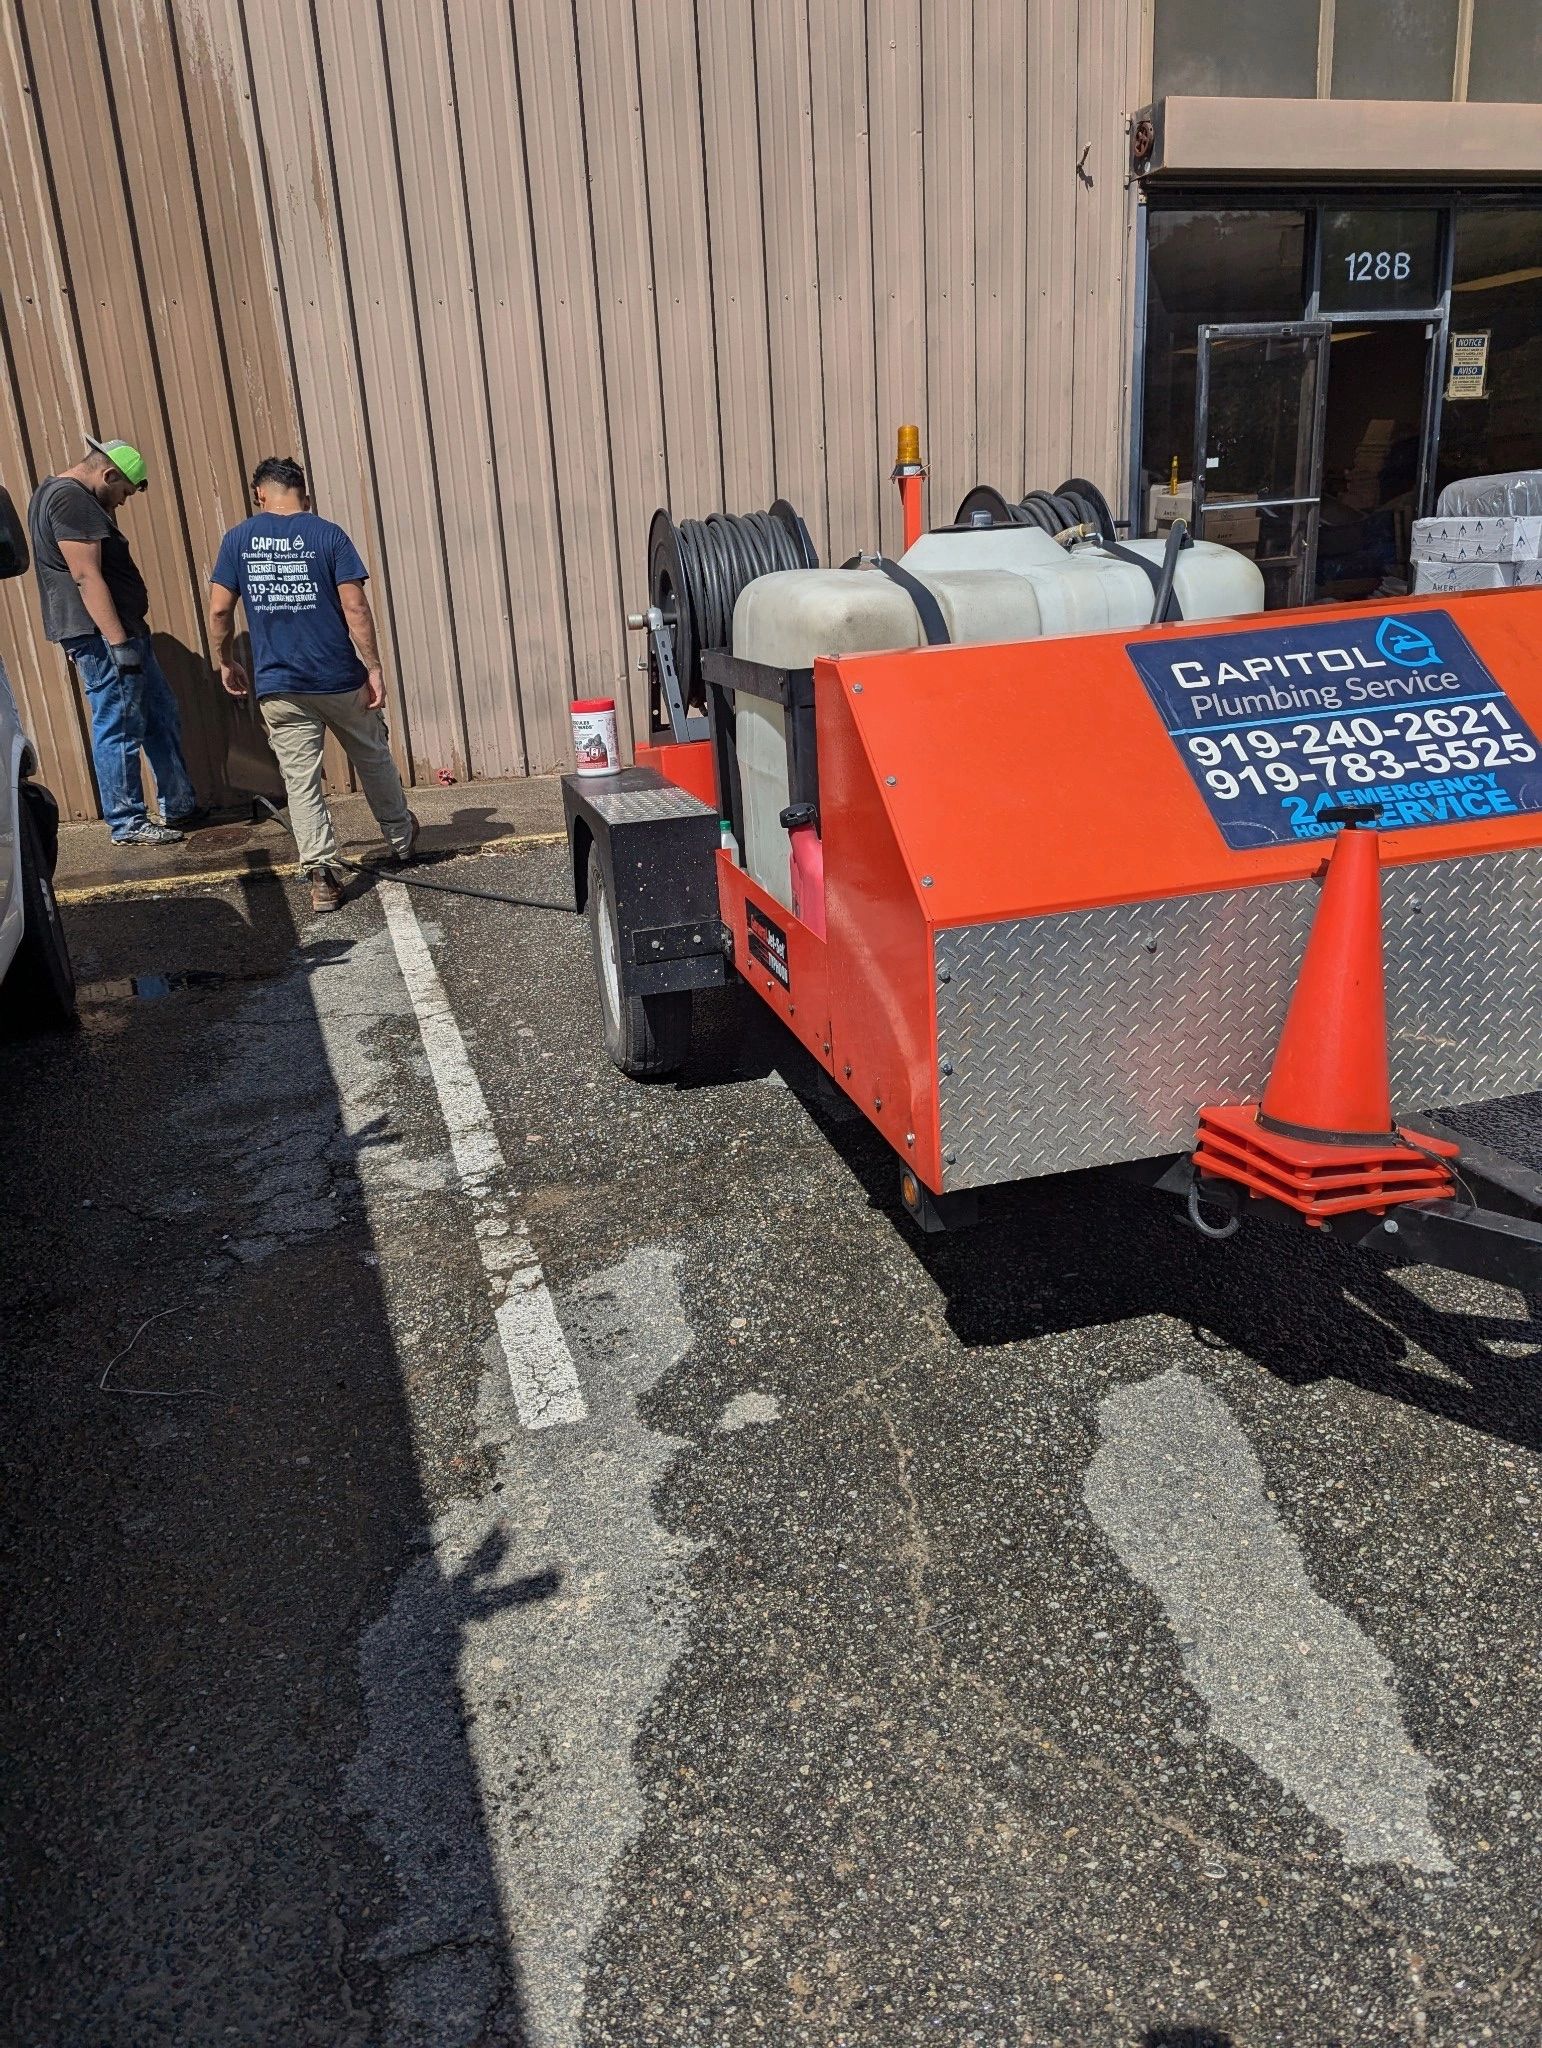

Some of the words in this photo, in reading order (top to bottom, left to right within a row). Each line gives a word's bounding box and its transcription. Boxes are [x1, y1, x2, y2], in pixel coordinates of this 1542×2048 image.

[1344, 251, 1411, 281] 128B
[1458, 338, 1482, 347] NOTICE
[1457, 366, 1478, 375] AVISO
[251, 536, 292, 552] CAPITOL
[241, 549, 273, 561] Pumbing
[247, 563, 276, 574] LICENSED
[247, 581, 319, 595] 919-240-2621
[1170, 647, 1387, 689] CAPITOL
[1190, 683, 1343, 720] Plumbing
[1347, 669, 1460, 702] Service
[1187, 701, 1513, 767] 919-240-2621
[1205, 732, 1538, 801] 919-783-5525
[1281, 792, 1335, 825] 24
[1335, 772, 1497, 806] EMERGENCY
[1291, 821, 1345, 838] HOU
